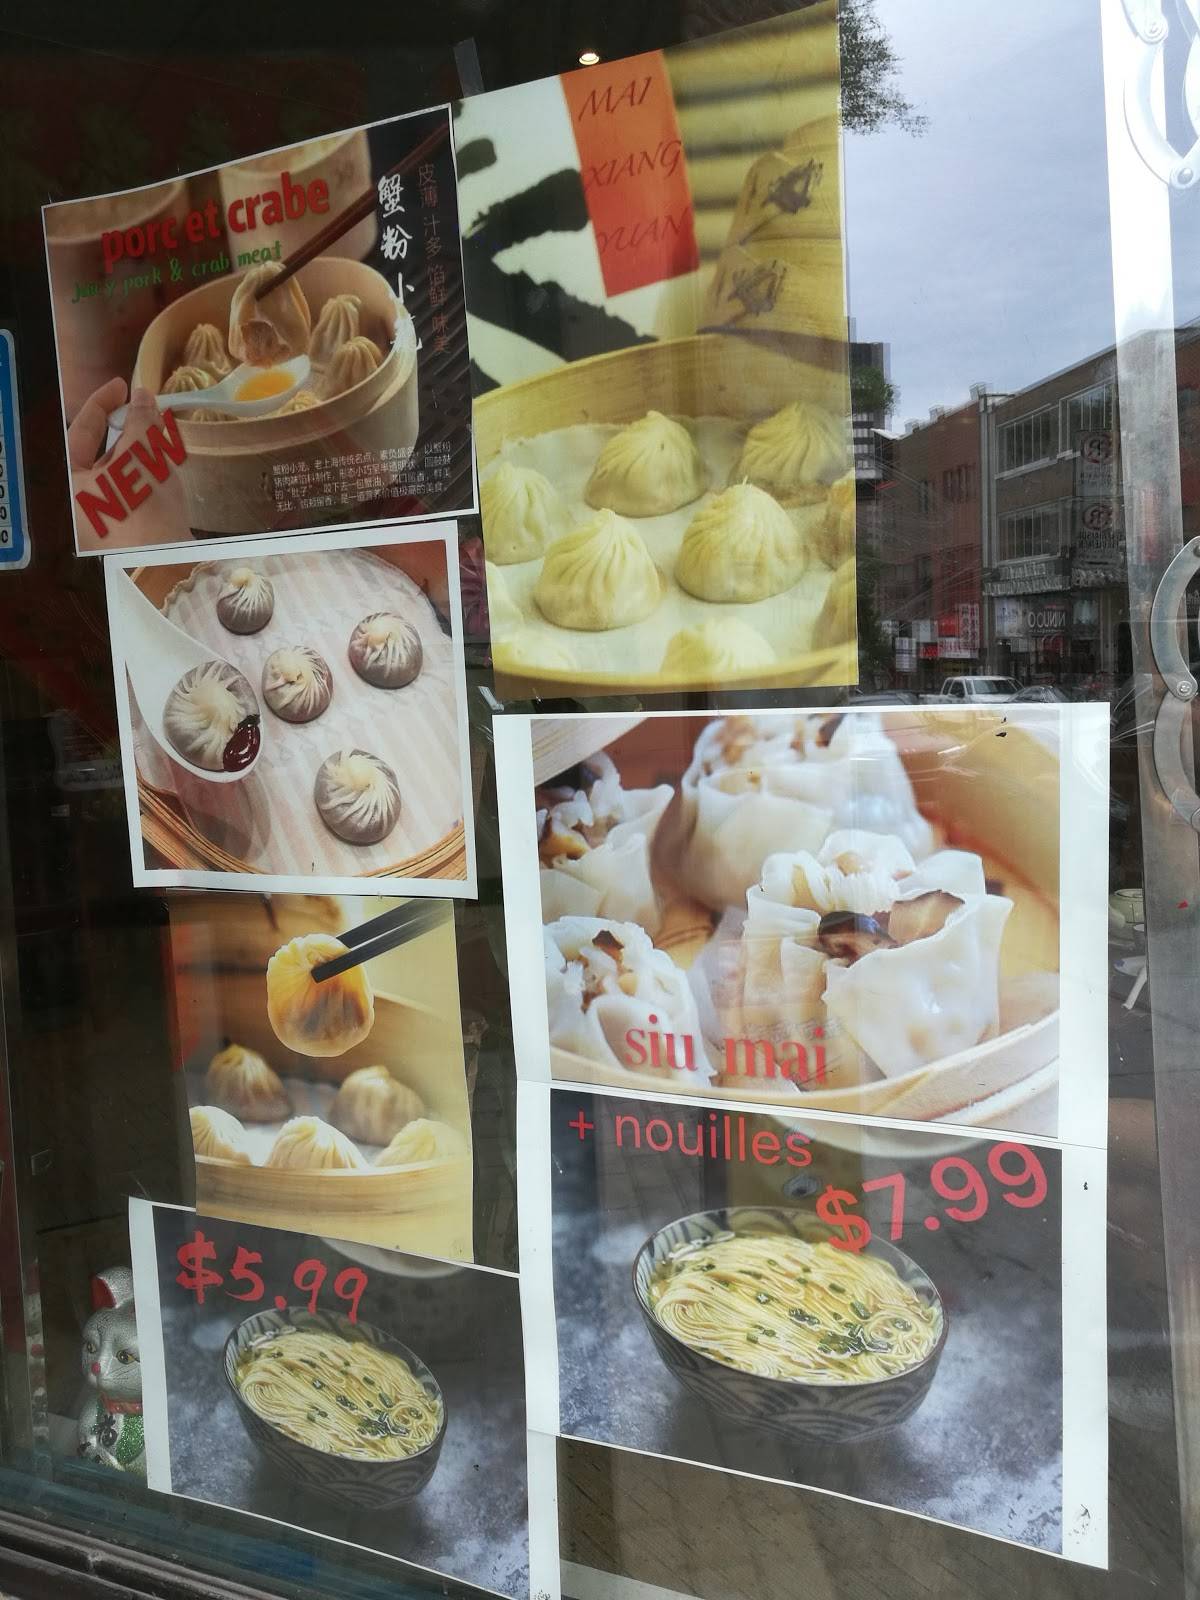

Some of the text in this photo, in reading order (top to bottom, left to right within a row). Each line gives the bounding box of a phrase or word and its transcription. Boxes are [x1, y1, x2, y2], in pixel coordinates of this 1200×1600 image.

[578, 76, 652, 123] MAI
[585, 140, 682, 192] XIANG
[101, 171, 330, 273] porc et crabe
[123, 267, 163, 298] pork
[191, 251, 231, 277] crab
[237, 239, 283, 267] meat
[75, 408, 188, 538] NEW
[624, 1013, 827, 1084] siu mai
[614, 1112, 813, 1167] nouilles
[815, 1142, 1048, 1255] $7.99
[176, 1230, 368, 1323] $5.99
